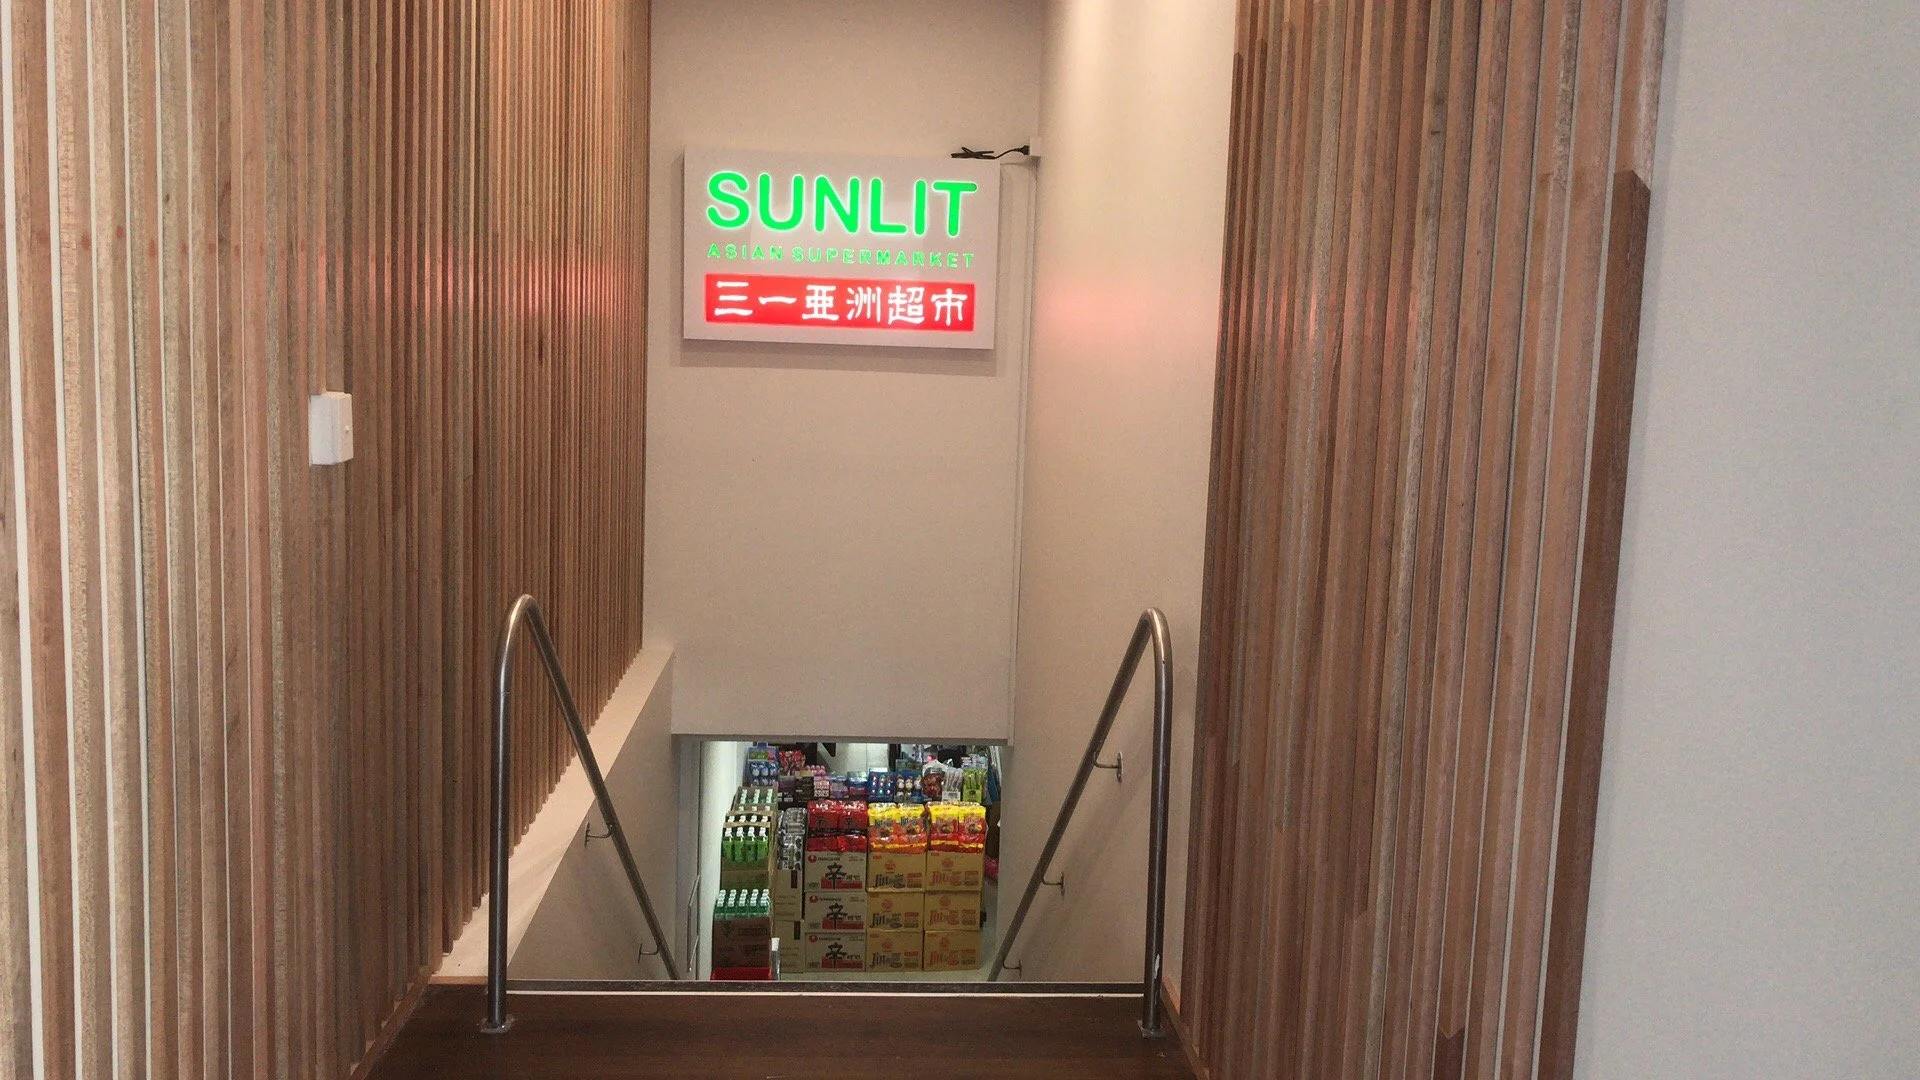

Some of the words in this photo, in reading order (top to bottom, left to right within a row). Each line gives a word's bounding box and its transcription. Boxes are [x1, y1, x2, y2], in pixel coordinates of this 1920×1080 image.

[706, 171, 978, 238] SUNLIT
[706, 243, 783, 261] ASIAN
[791, 246, 975, 269] SUPERMARKET
